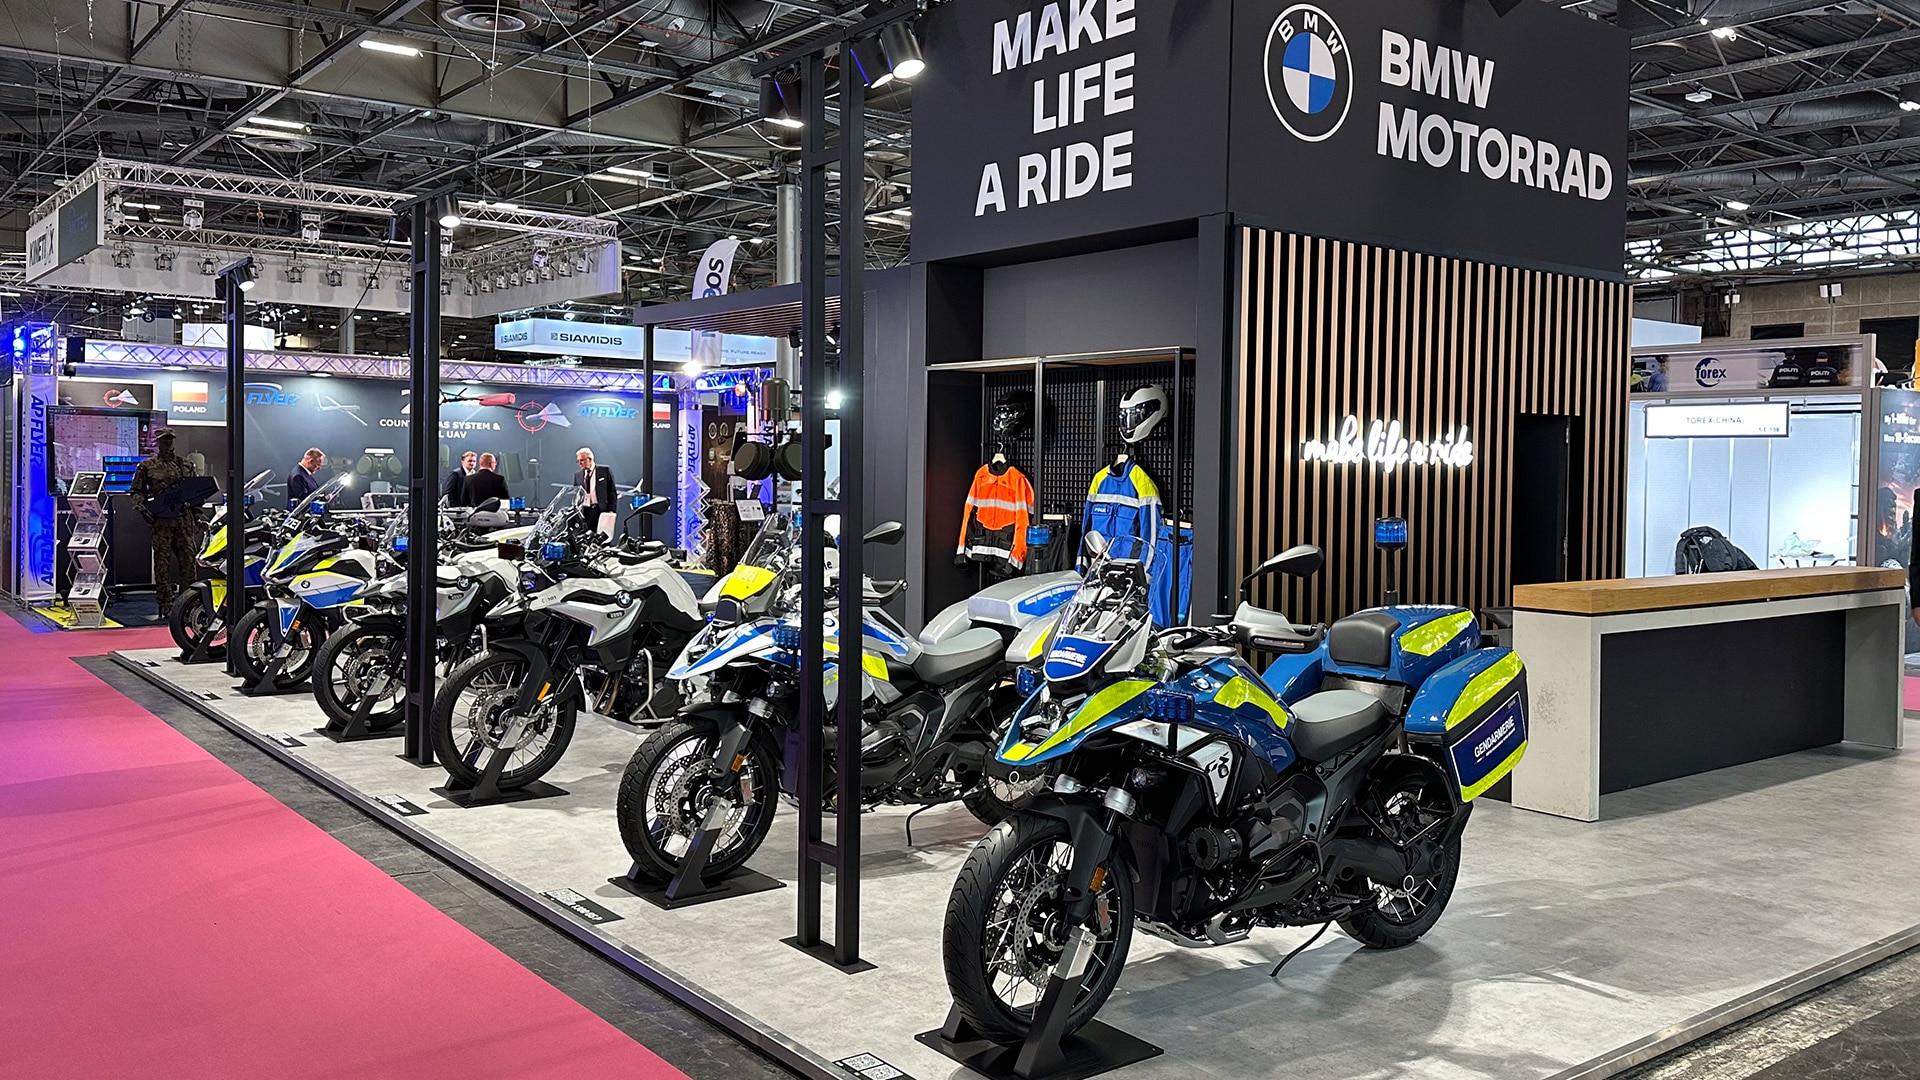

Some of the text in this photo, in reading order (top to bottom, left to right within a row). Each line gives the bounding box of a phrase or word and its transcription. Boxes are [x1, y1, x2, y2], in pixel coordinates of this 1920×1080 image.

[992, 0, 1136, 75] MAKE
[1277, 11, 1343, 55] BMW
[1380, 29, 1495, 109] BMW
[1033, 52, 1136, 134] LIFE
[1377, 101, 1613, 201] MOTORRAD
[975, 130, 1134, 217] A RIDE
[559, 333, 623, 346] SIAMIDIS
[1695, 365, 1727, 379] Torex
[173, 405, 207, 413] POLAND
[247, 392, 300, 406] FLYER
[578, 406, 639, 418] AP FLYER
[30, 394, 47, 468] AP FLYER
[446, 431, 467, 439] UAV
[452, 421, 490, 430] SYSTEM
[492, 422, 500, 430] &
[1367, 419, 1409, 474] life
[1474, 715, 1515, 758] GENDARMERIE
